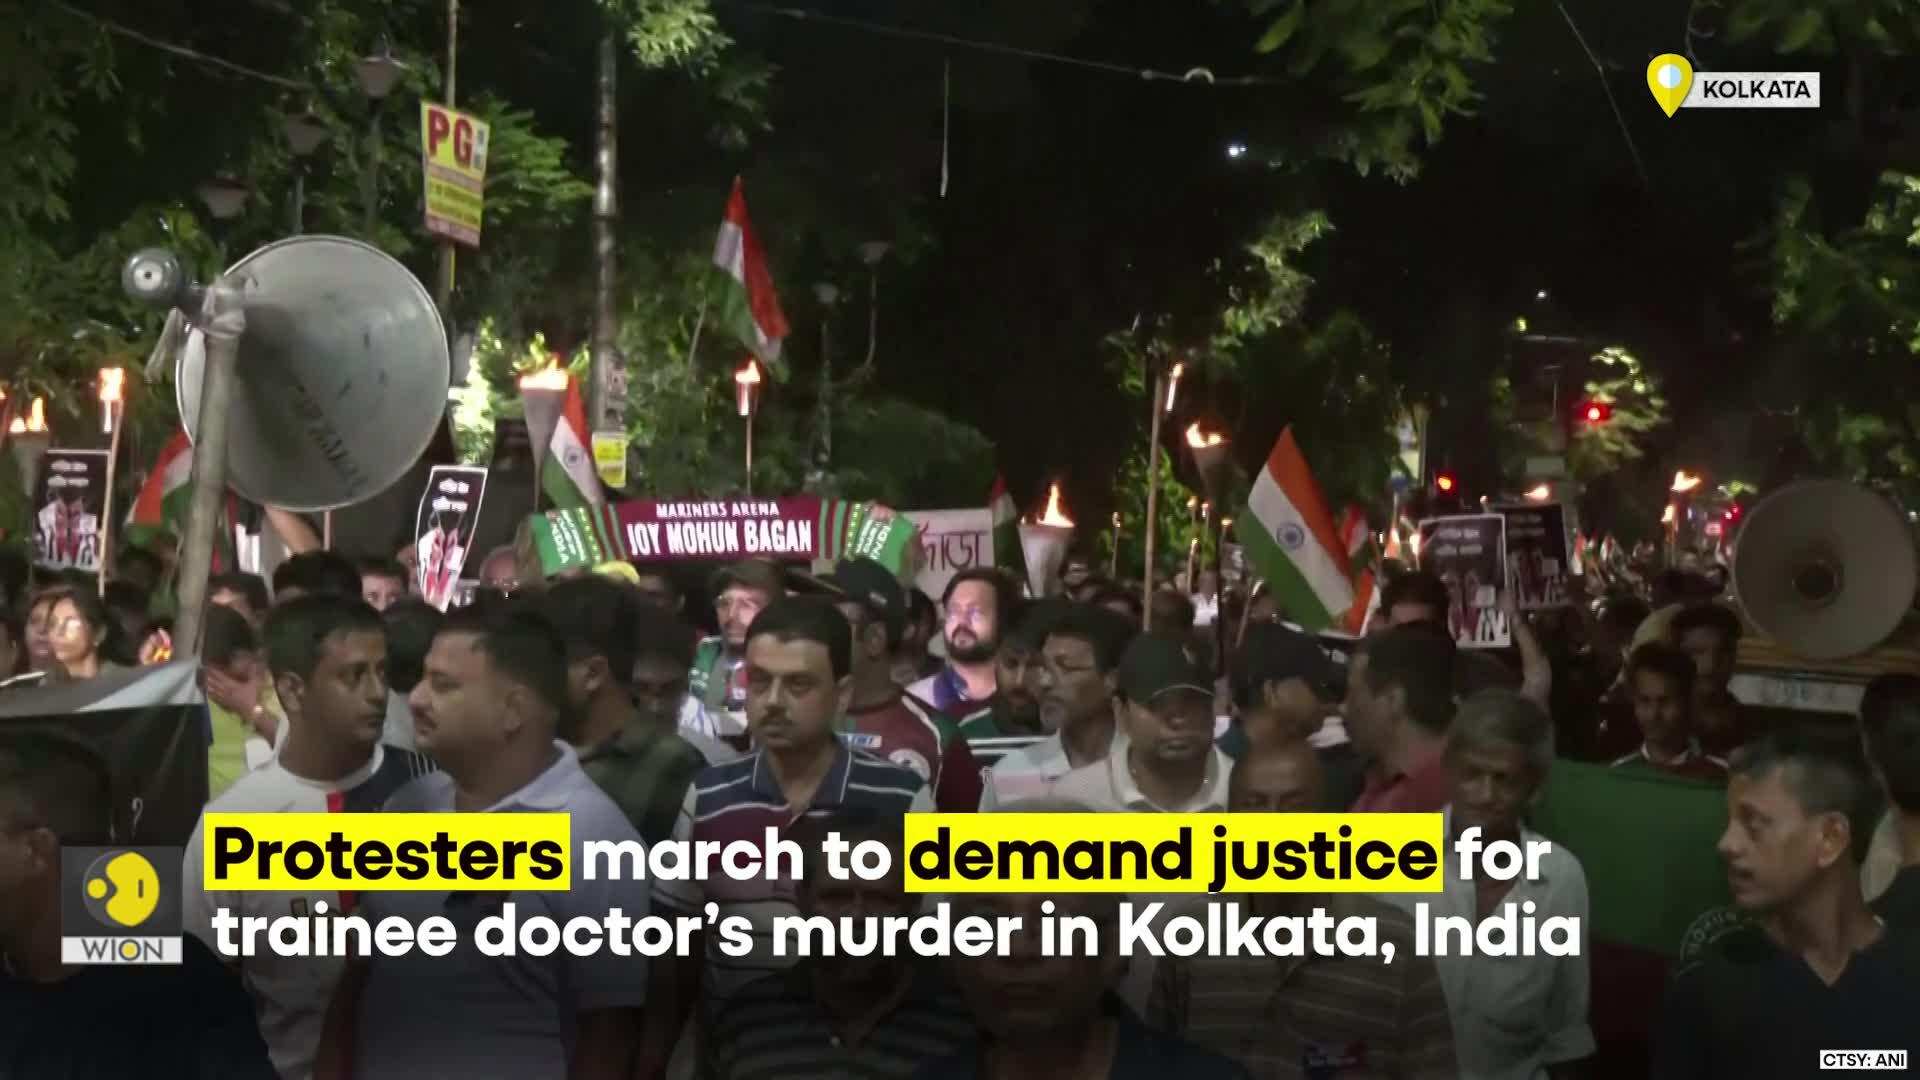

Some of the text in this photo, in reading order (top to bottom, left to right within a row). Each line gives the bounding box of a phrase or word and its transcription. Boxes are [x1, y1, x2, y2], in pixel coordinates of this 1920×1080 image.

[428, 109, 473, 169] PG
[656, 501, 780, 519] MARINERS ARENA
[626, 522, 662, 556] JOY
[665, 520, 740, 554] MOHUN
[743, 519, 812, 553] BAGAN
